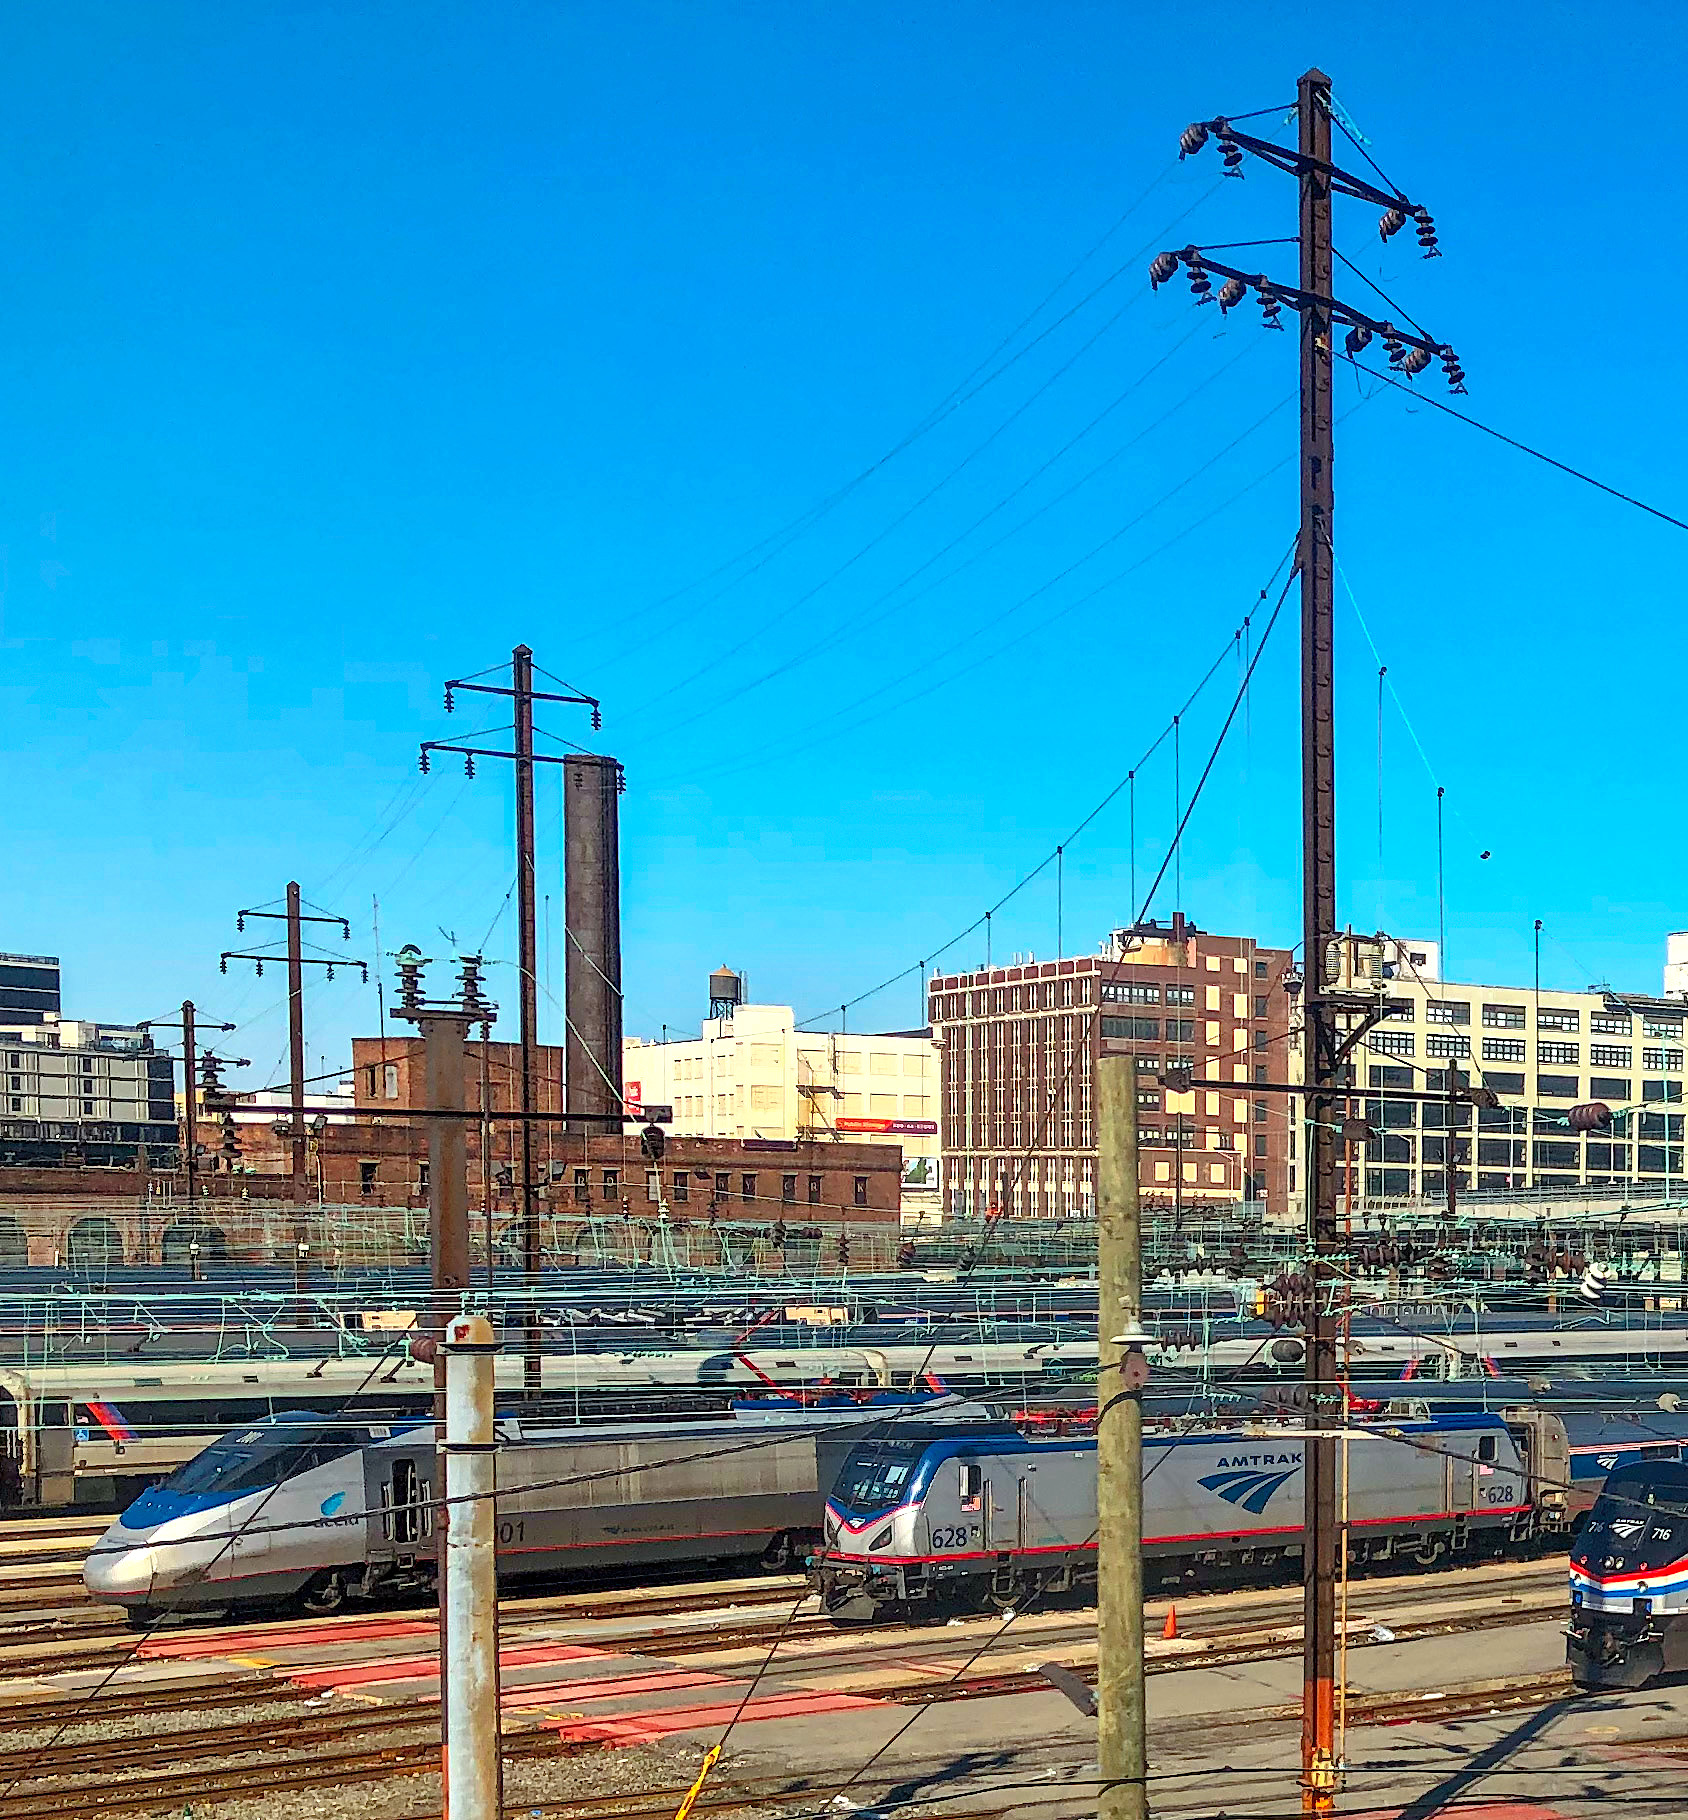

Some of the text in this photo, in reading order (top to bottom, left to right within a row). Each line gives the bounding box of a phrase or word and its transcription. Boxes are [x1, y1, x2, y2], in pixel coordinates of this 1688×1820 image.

[1217, 1453, 1303, 1468] AMTRAK
[1488, 1485, 1514, 1504] 628
[932, 1527, 968, 1549] 628
[1651, 1527, 1673, 1541] 716
